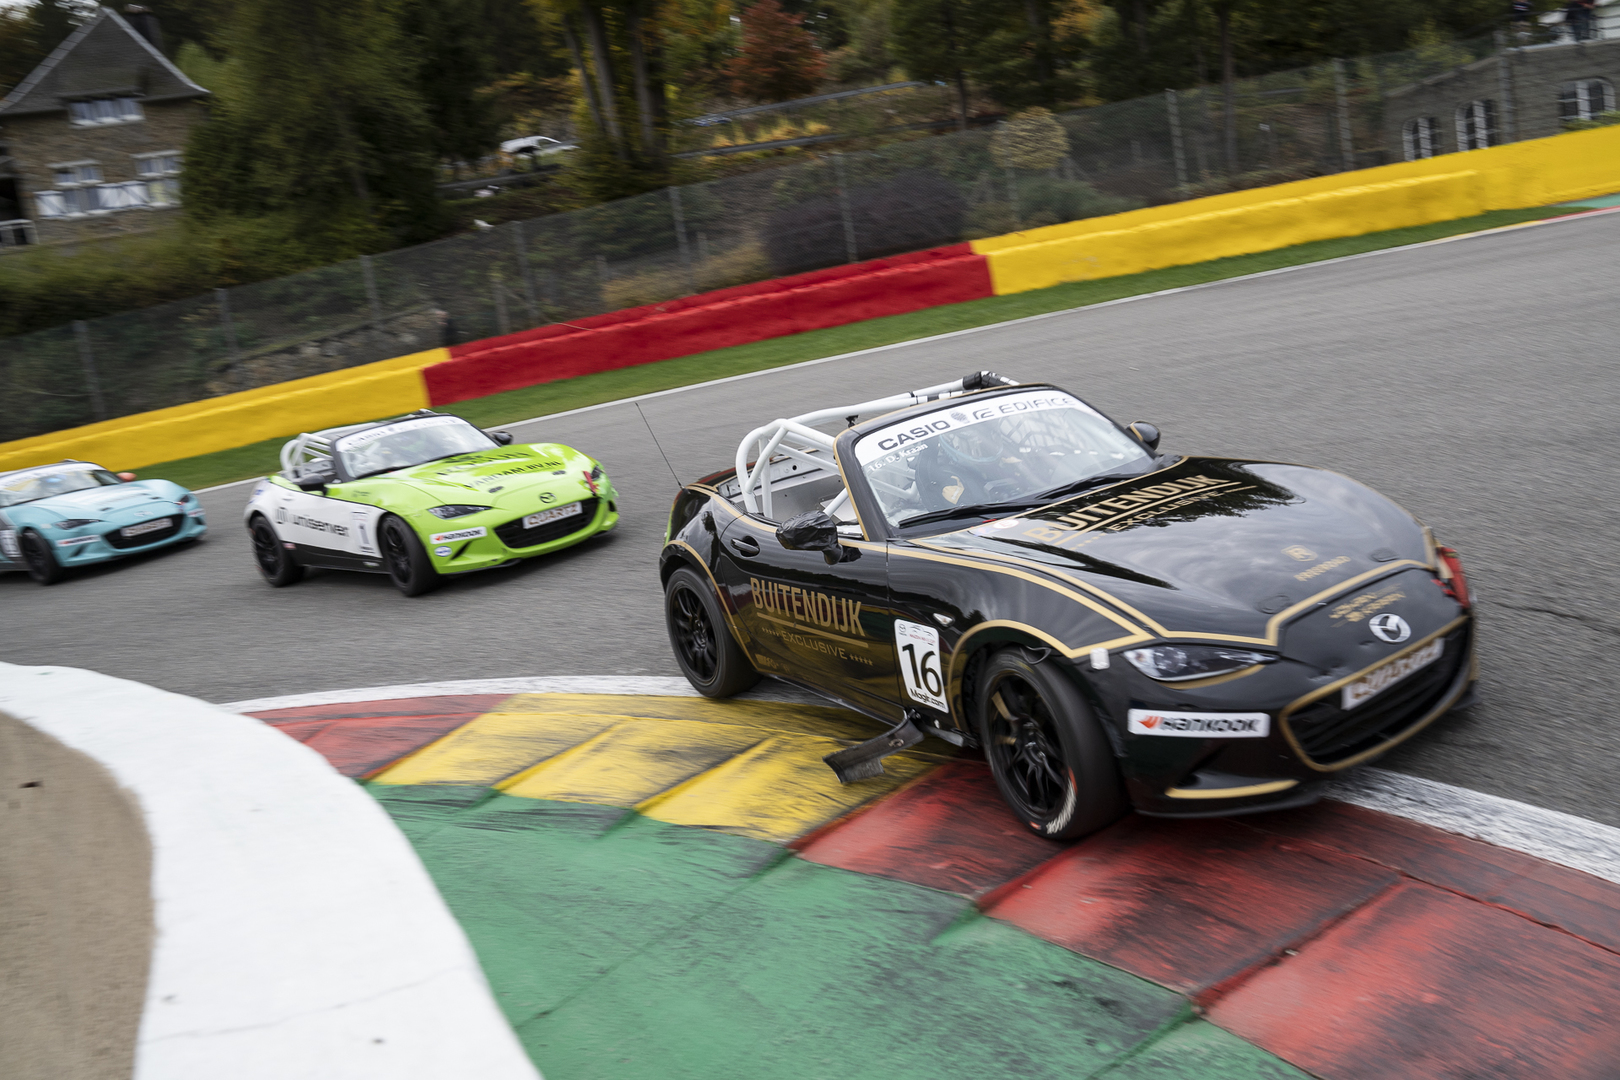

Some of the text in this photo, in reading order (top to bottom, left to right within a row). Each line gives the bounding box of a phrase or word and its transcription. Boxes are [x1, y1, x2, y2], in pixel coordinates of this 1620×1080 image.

[877, 396, 1076, 451] CASIO EDIFICE
[1022, 475, 1231, 542] BUITENDIJK
[1107, 490, 1225, 532] EXCLUSIVE
[750, 577, 866, 637] BUITENDIJK
[780, 629, 848, 660] EXCLUSIVE
[902, 643, 942, 697] 16
